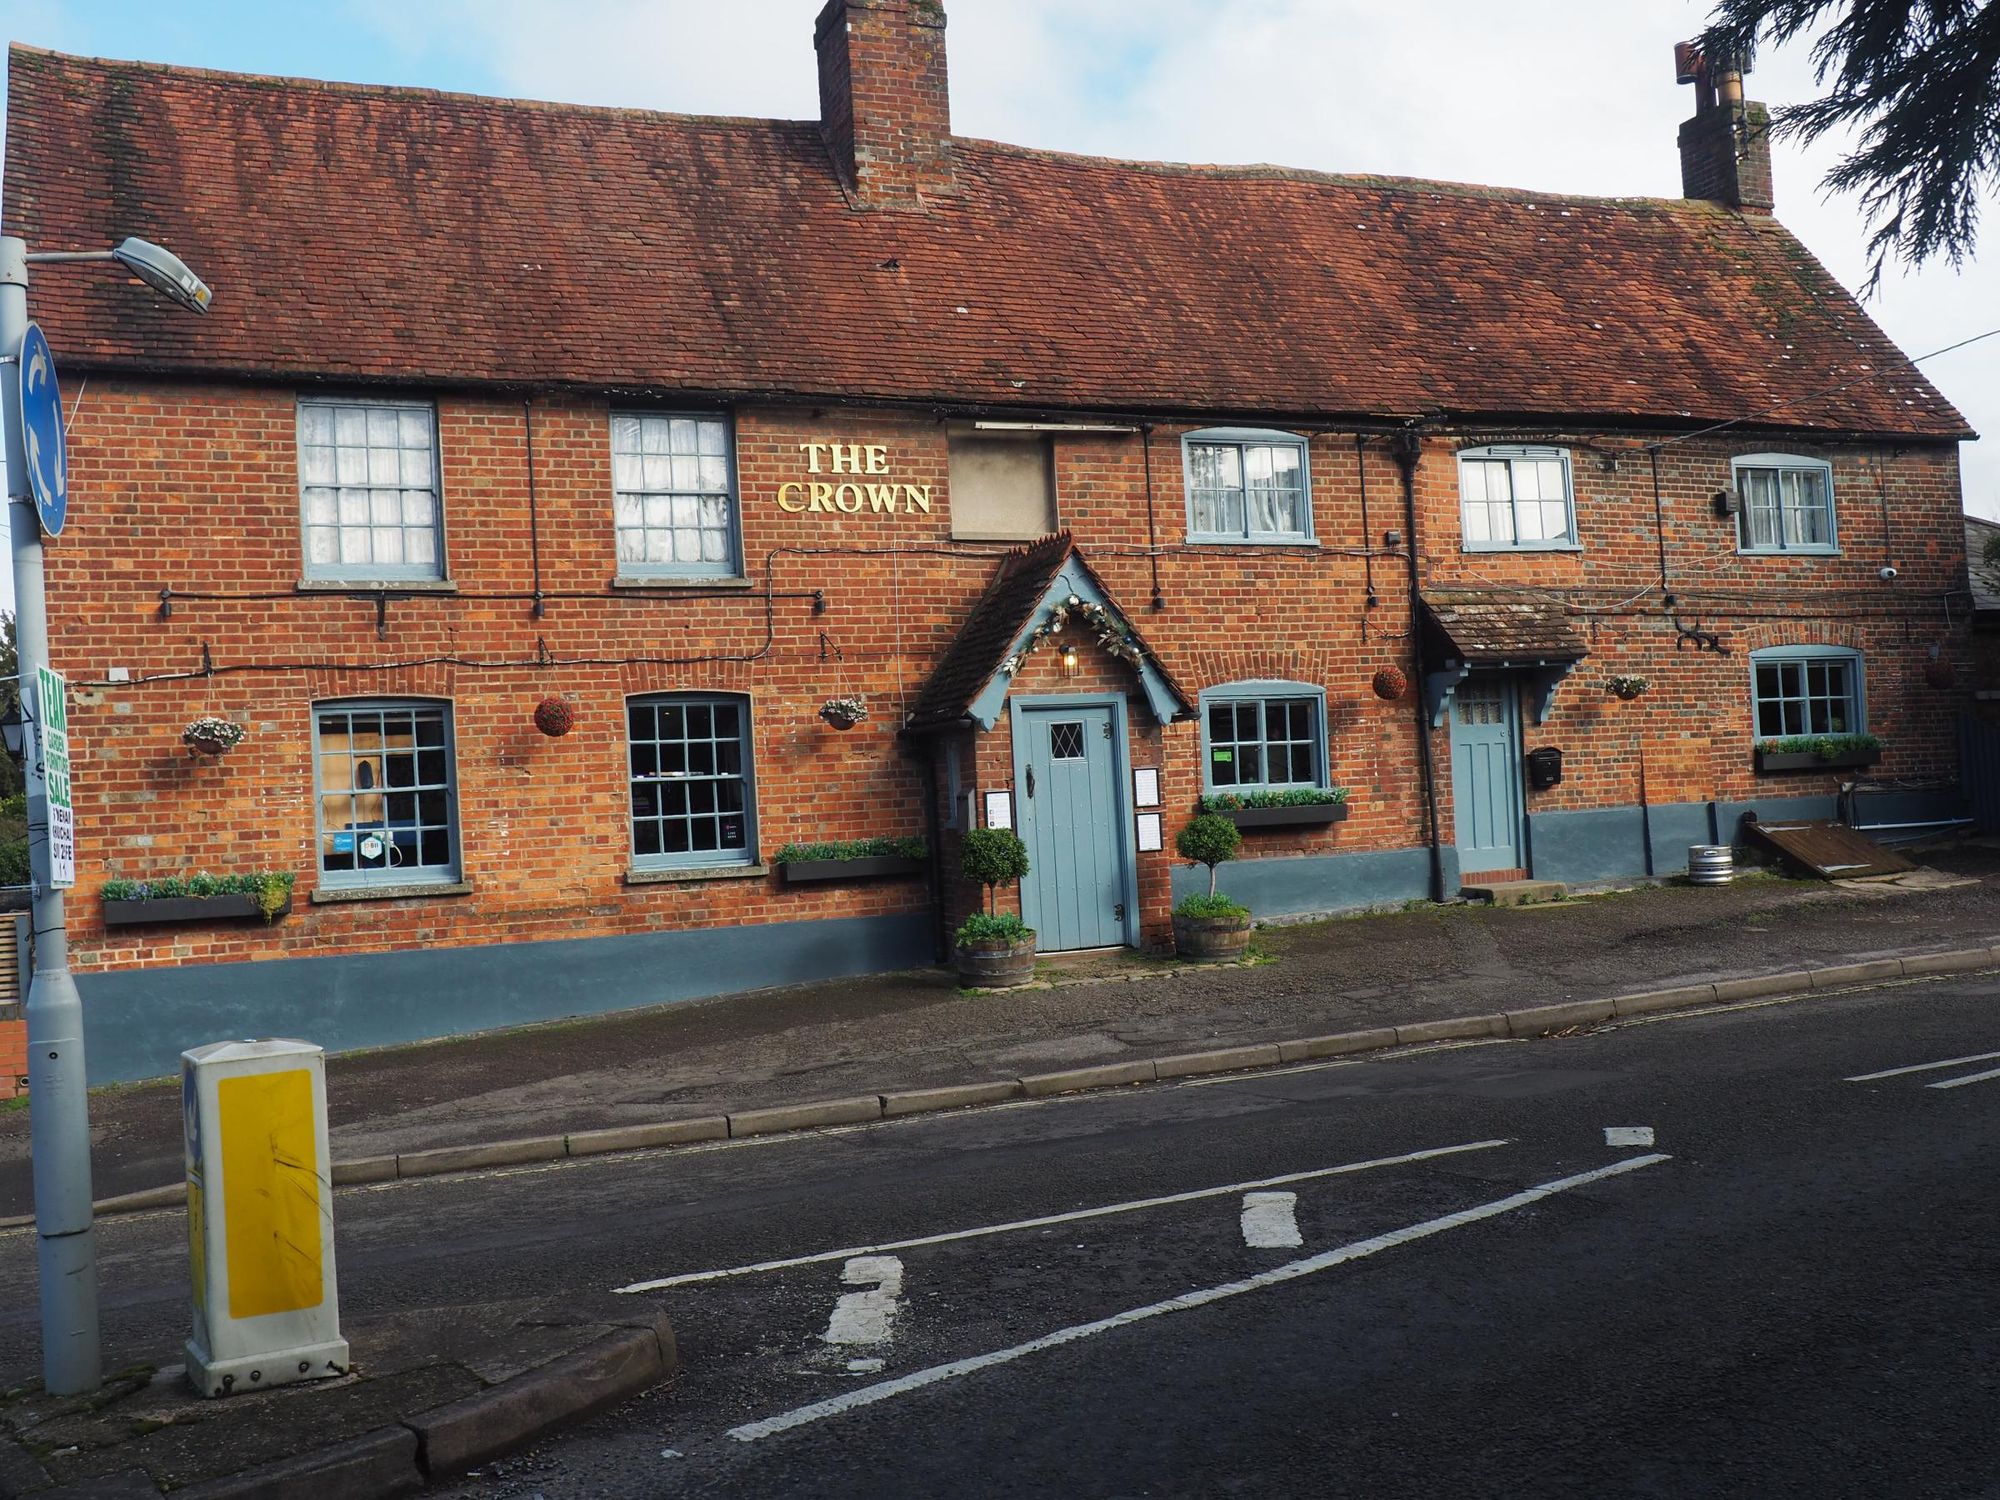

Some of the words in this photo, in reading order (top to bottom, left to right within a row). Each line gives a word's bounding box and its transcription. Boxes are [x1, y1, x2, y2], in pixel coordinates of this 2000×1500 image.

[799, 443, 889, 475] THE
[777, 482, 931, 514] CROWN
[39, 667, 66, 733] TEAK
[47, 731, 65, 753] GARDEN
[45, 750, 69, 775] FURNITURE
[48, 772, 71, 808] SALE
